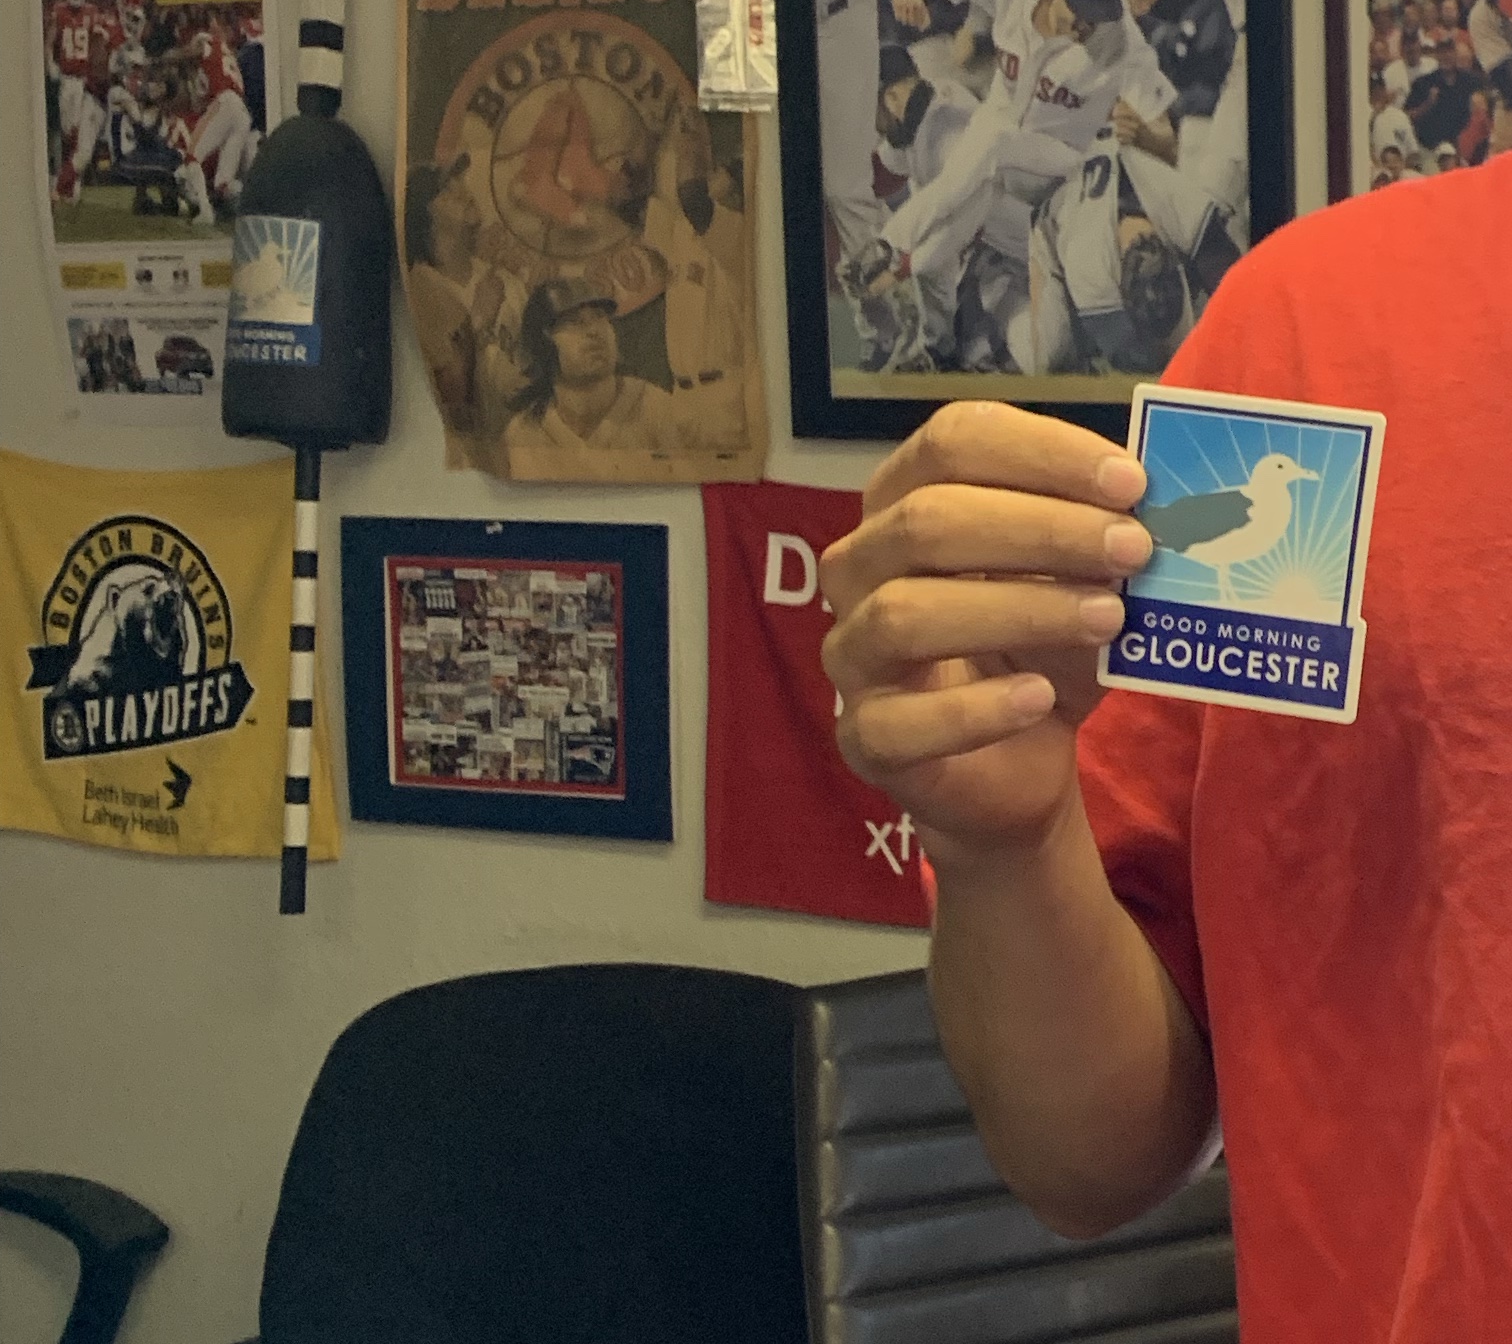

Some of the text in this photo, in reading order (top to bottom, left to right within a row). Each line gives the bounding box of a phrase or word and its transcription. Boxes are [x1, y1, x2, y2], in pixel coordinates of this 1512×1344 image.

[466, 29, 685, 128] BOSTON
[50, 528, 226, 651] BOSTON BRUINS
[1119, 630, 1341, 693] GLOUCESTER
[1143, 611, 1322, 653] GOOD MORNING
[83, 672, 233, 747] PLAYOFFS
[82, 804, 179, 836] Lahey Health
[85, 779, 119, 805] Beth
